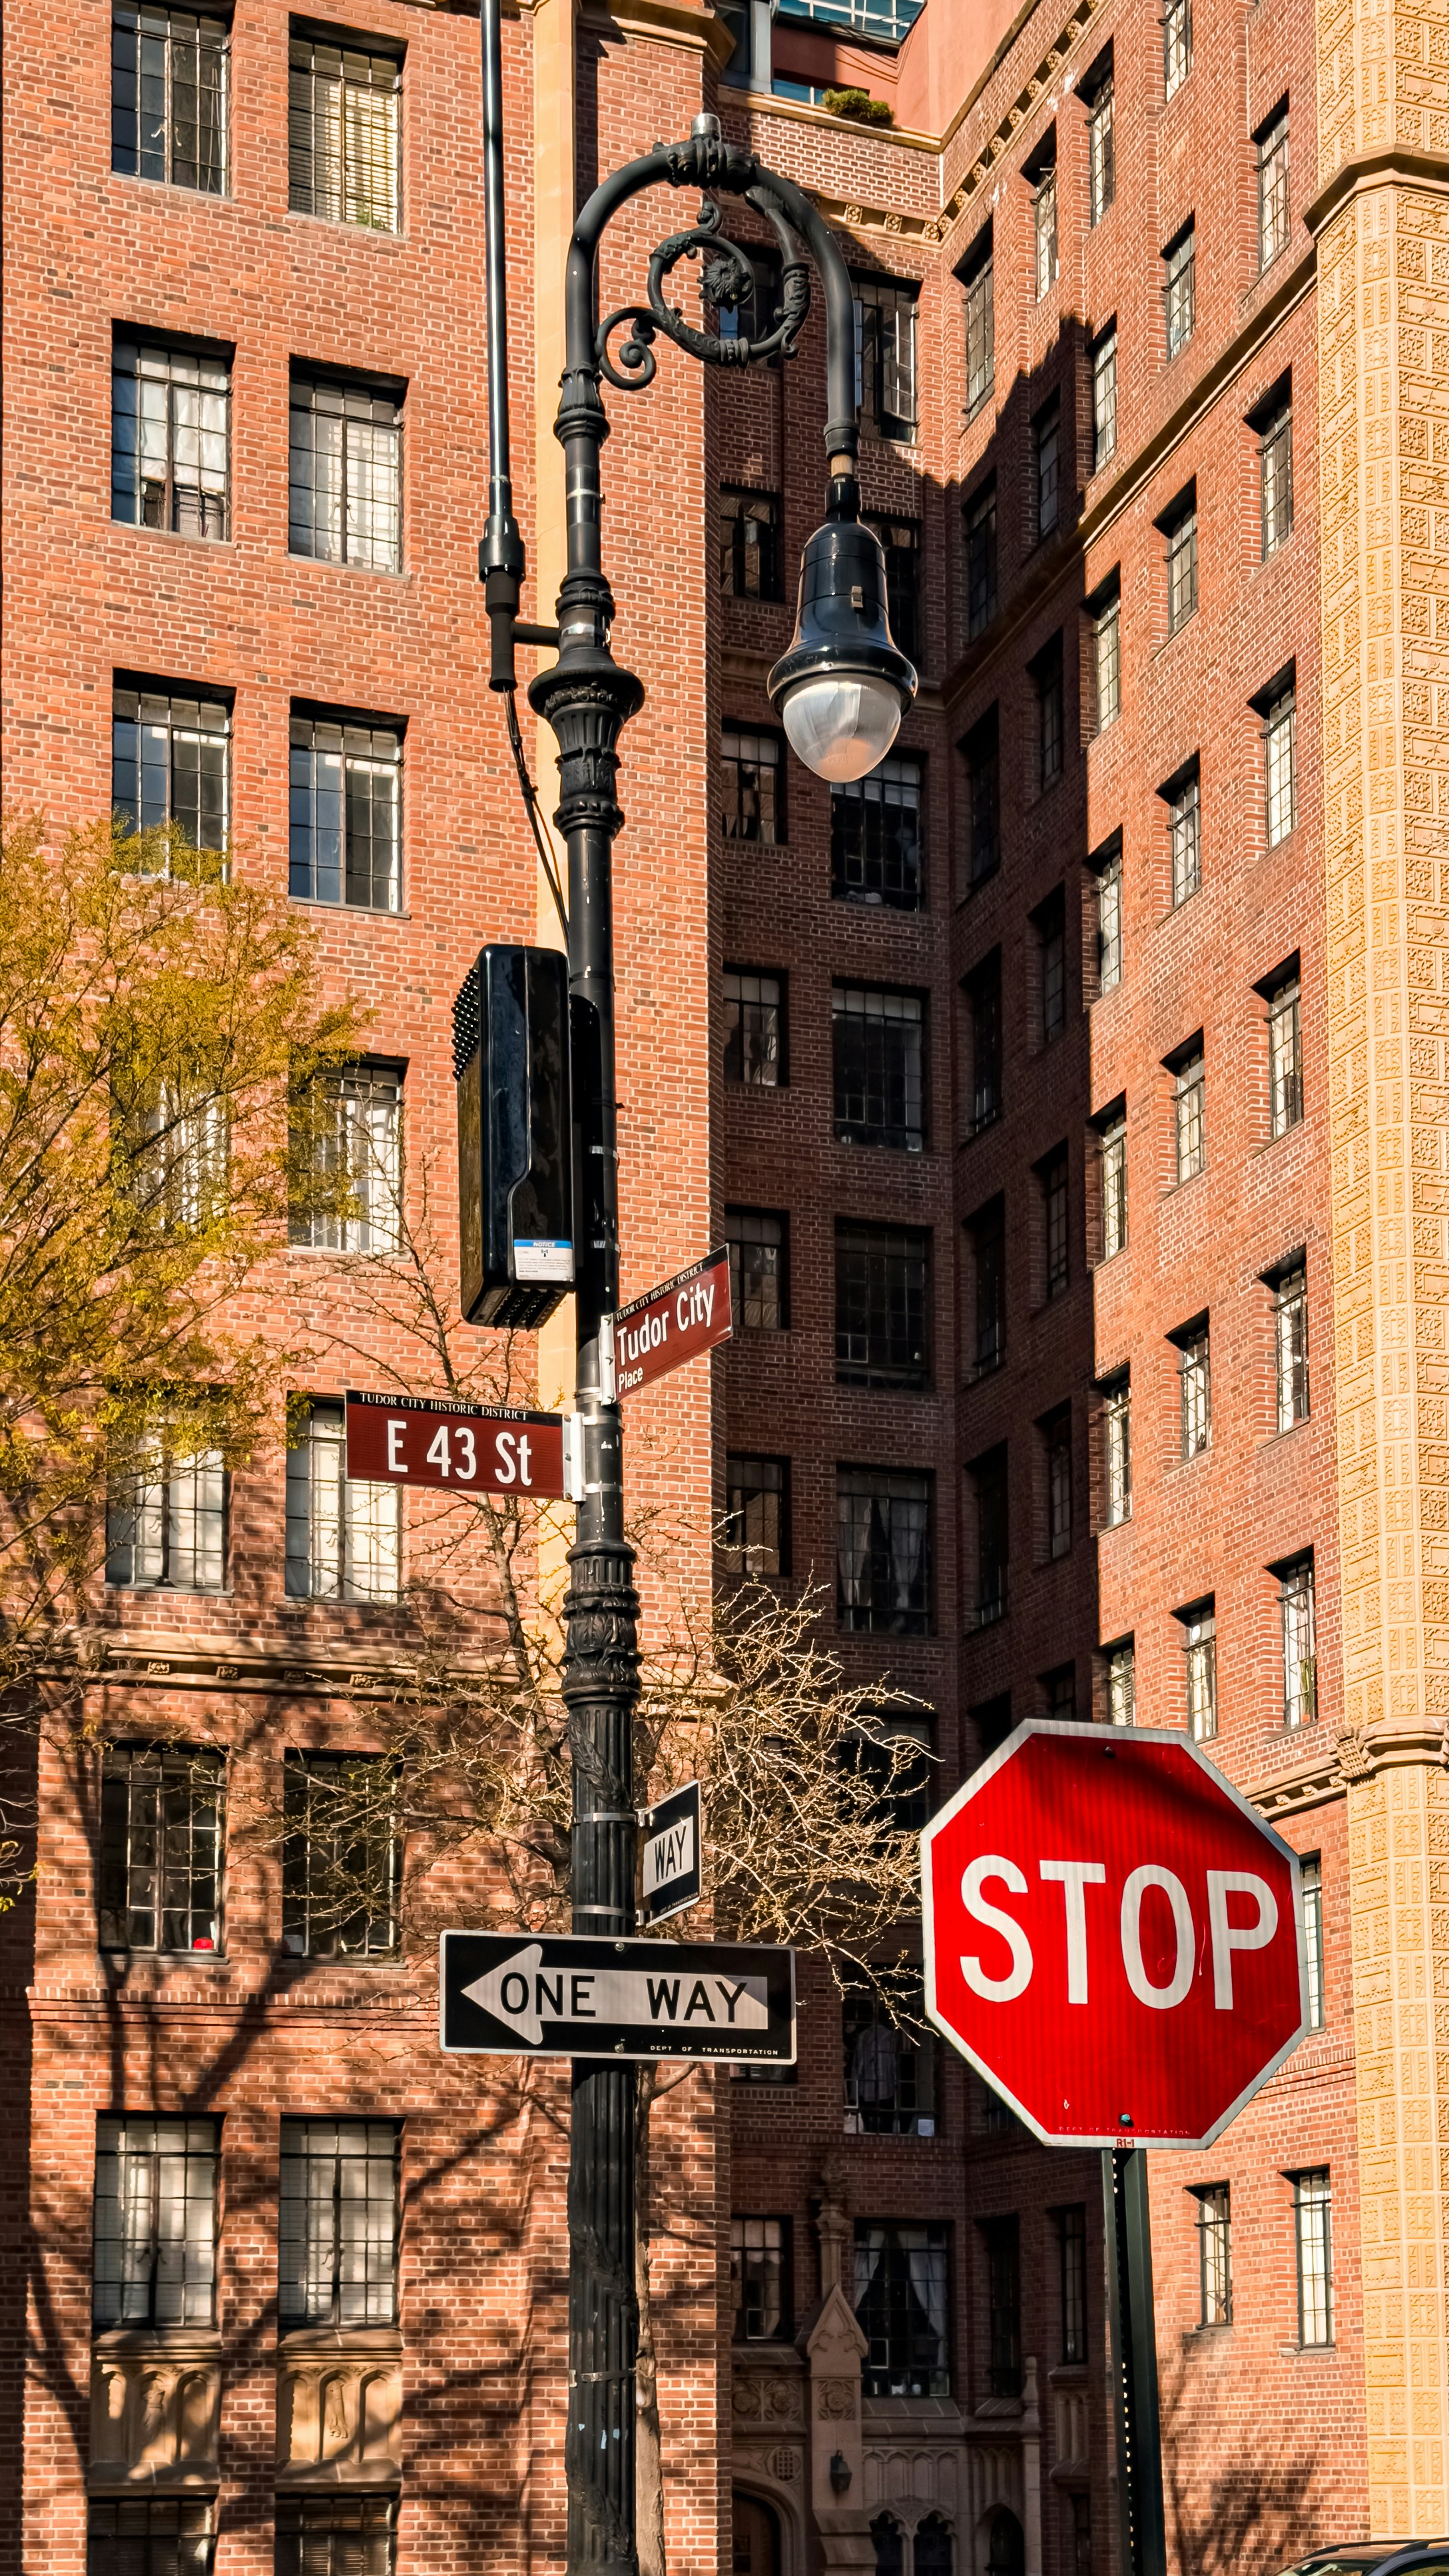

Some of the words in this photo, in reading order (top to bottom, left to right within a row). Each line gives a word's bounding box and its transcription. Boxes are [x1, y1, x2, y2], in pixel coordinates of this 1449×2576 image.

[617, 1304, 635, 1321] TUDOR
[635, 1295, 649, 1310] CITY
[651, 1279, 676, 1301] HISTORIC
[677, 1262, 704, 1285] DISTRICT
[617, 1311, 669, 1367] Tudor
[676, 1282, 715, 1332] City
[360, 1393, 397, 1407] TUDOR
[401, 1397, 426, 1410] CITY
[430, 1401, 477, 1415] HISTORIC
[481, 1407, 529, 1421] DISTRICT
[619, 1367, 643, 1393] Place
[387, 1419, 408, 1473] E
[426, 1425, 477, 1480] 43
[494, 1432, 533, 1486] St
[655, 1825, 687, 1883] WAY
[960, 1854, 1279, 2010] STOP
[500, 1971, 596, 2018] ONE
[645, 1977, 748, 2023] WAY
[1117, 2138, 1135, 2148] R1-1
